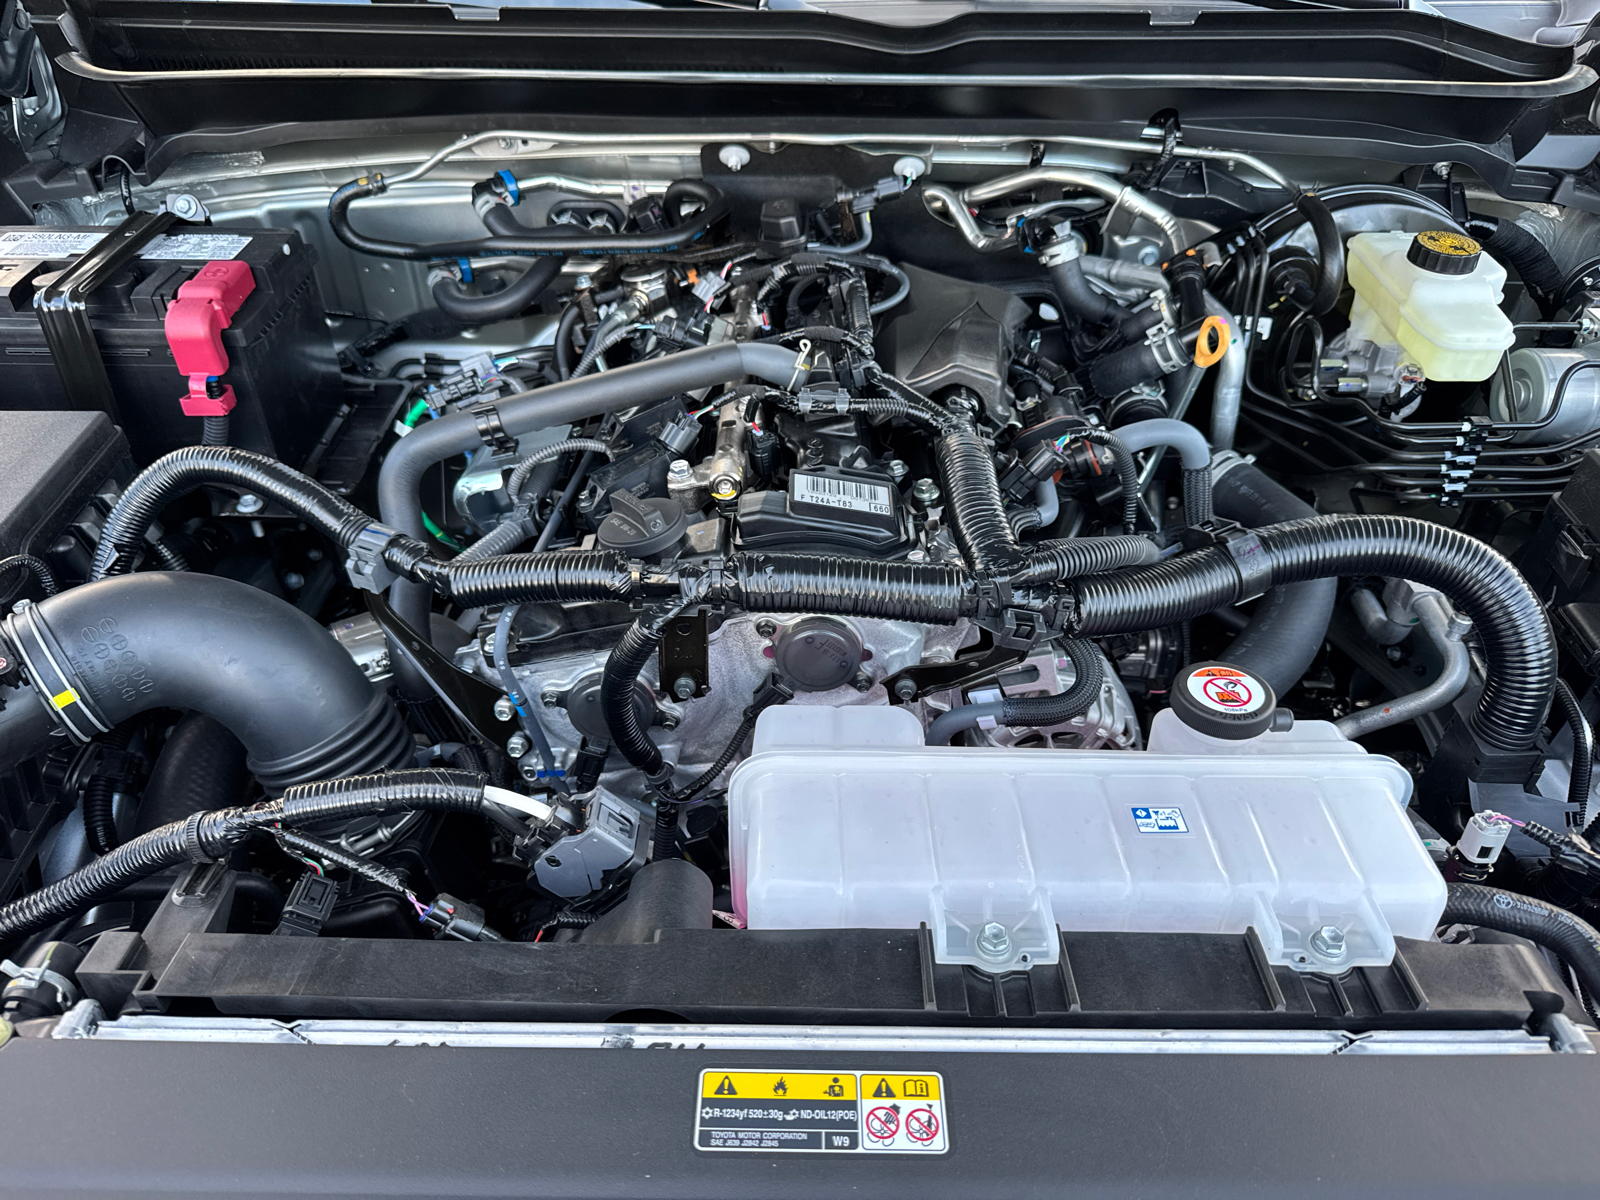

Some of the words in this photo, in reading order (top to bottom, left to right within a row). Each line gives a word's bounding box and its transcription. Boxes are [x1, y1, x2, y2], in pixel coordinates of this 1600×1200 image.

[809, 495, 853, 508] T24A-T83
[873, 504, 890, 513] 660
[610, 518, 623, 526] SAE
[713, 1107, 748, 1121] R-1234yf
[748, 1108, 784, 1121] 520±30g
[800, 1109, 857, 1122] ND-OIL12(POE)
[711, 1131, 737, 1139] TOYOTA
[738, 1131, 761, 1139] MOTOR
[762, 1132, 808, 1140] CORPORATION
[725, 1139, 740, 1147] J639
[832, 1135, 851, 1147] W9
